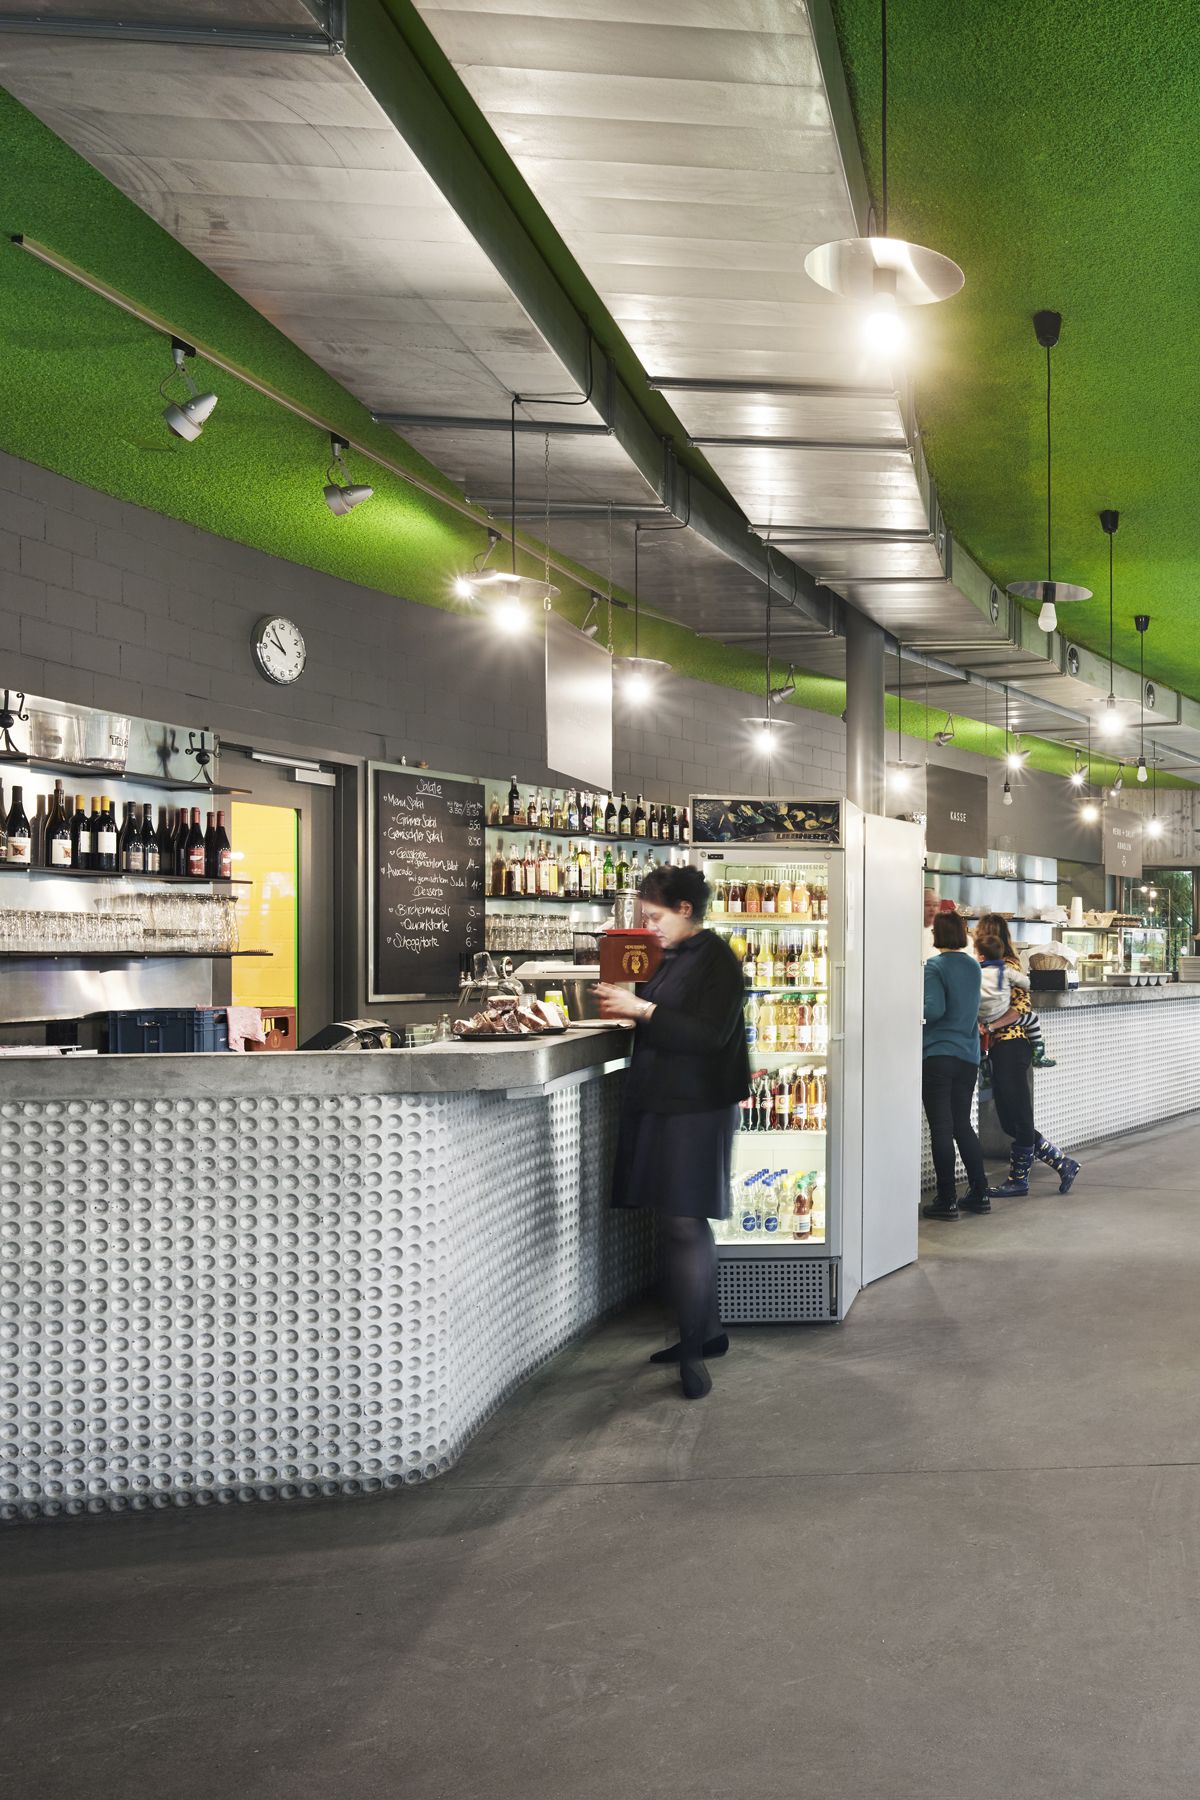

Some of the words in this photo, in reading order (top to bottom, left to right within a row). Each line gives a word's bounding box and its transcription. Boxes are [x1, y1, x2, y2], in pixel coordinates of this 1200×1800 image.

[279, 623, 286, 631] 12
[416, 779, 442, 794] Salate
[406, 795, 425, 811] Salat
[421, 814, 437, 828] Salat
[950, 811, 967, 823] KASSE
[425, 830, 444, 844] Salat
[387, 862, 413, 878] Avocado
[412, 886, 444, 897] Desserts
[404, 918, 450, 932] Quarktorte
[392, 932, 440, 954] Schoggitorte
